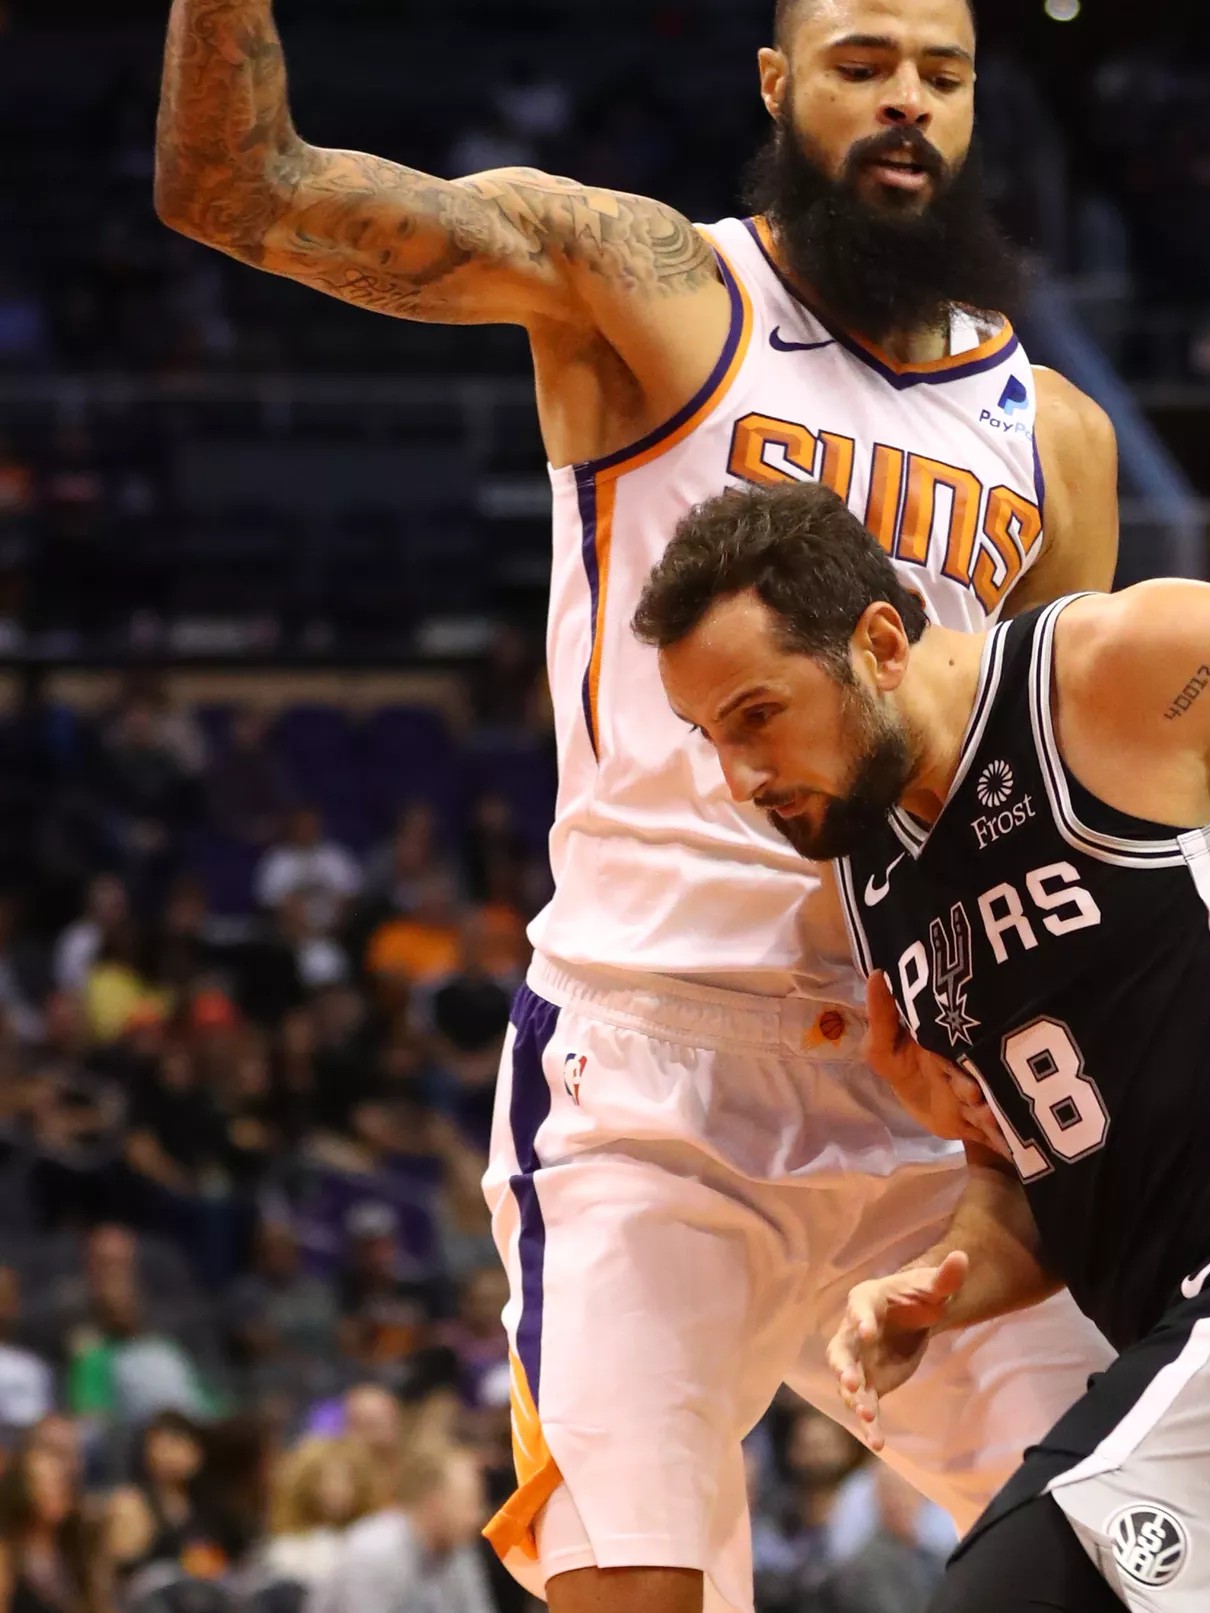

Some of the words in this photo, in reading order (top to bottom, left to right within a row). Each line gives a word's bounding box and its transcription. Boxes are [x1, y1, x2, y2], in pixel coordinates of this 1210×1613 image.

[979, 409, 1033, 442] PayPa
[970, 794, 1036, 850] Frost
[884, 861, 1101, 1046] PURS
[956, 1014, 1111, 1184] 18
